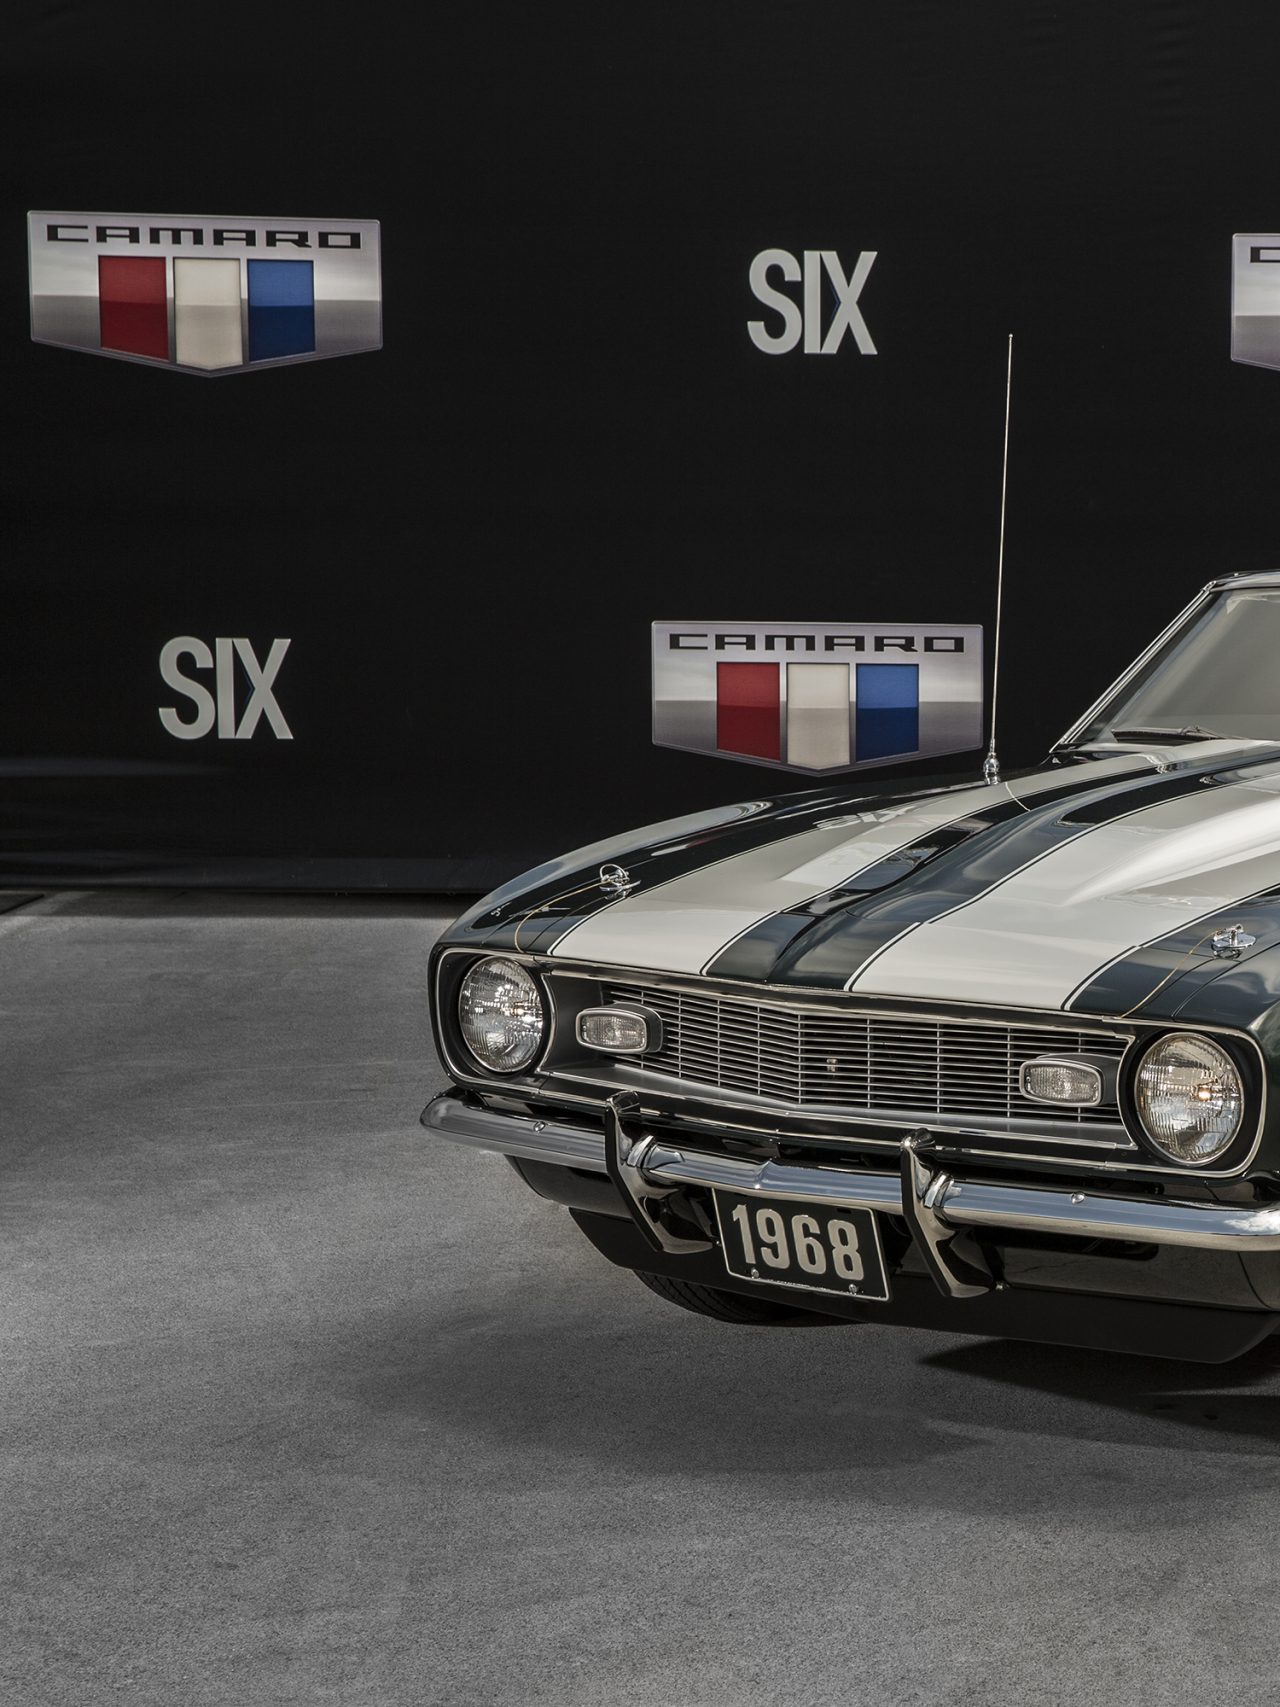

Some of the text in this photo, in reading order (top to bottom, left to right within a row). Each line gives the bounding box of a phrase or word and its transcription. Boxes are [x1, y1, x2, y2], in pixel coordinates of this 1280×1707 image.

[46, 224, 361, 249] CAMARO
[747, 248, 878, 355] SIX
[669, 633, 965, 653] CAMARO
[158, 636, 294, 740] SIX
[732, 1204, 864, 1281] 1968
